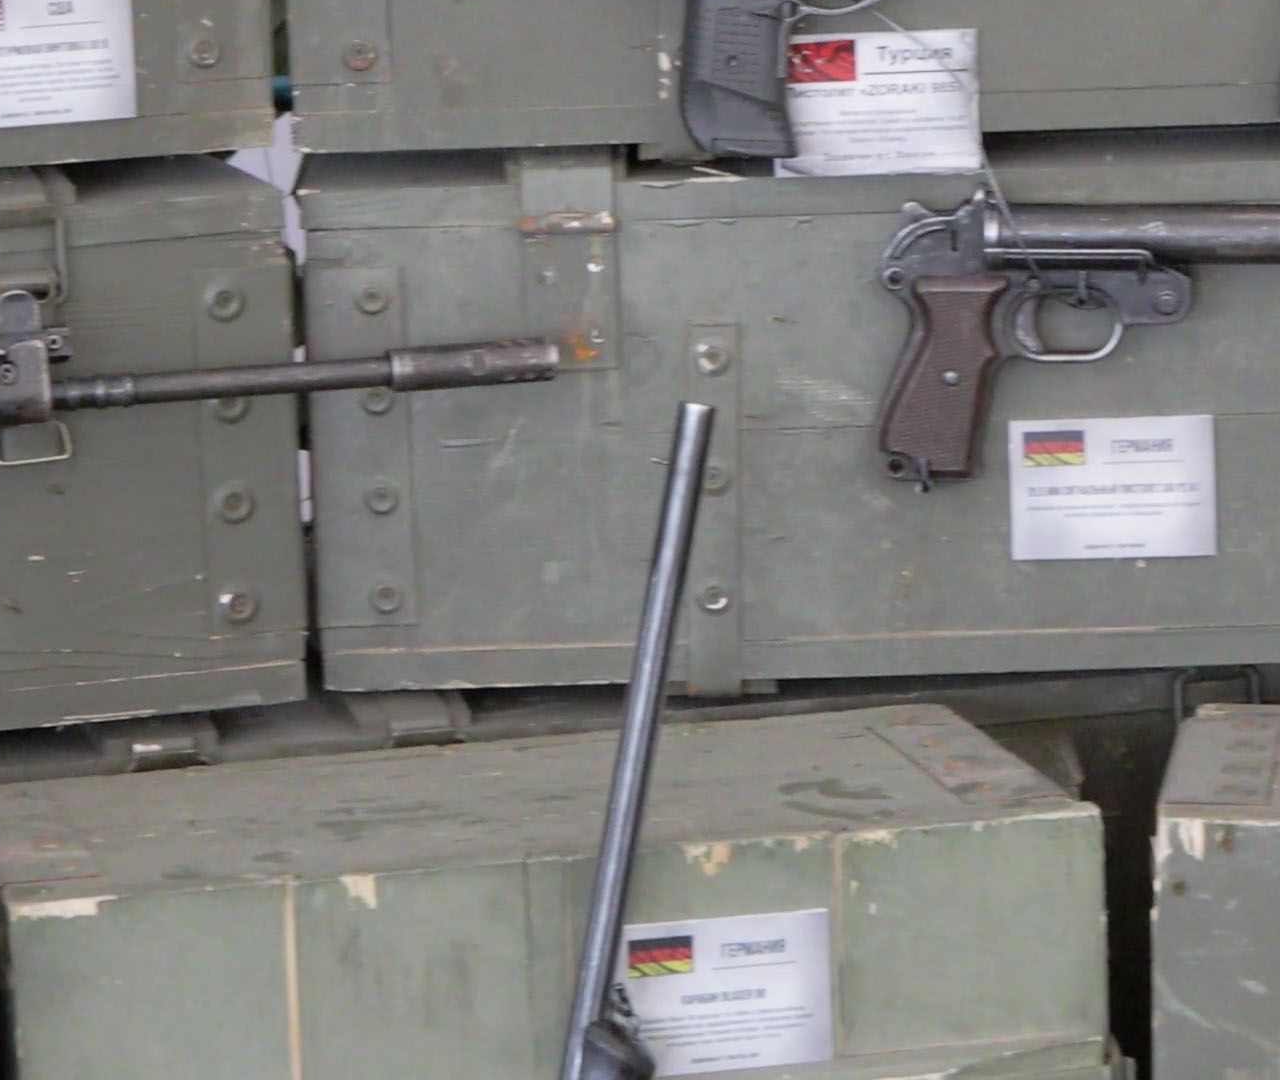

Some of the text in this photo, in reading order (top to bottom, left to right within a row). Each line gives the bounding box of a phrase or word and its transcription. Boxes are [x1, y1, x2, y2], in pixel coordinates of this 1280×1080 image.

[876, 46, 953, 66] Турция
[1110, 438, 1174, 454] ГЕРМАНИЯ
[721, 938, 787, 958] ГЕРМАНИЯ
